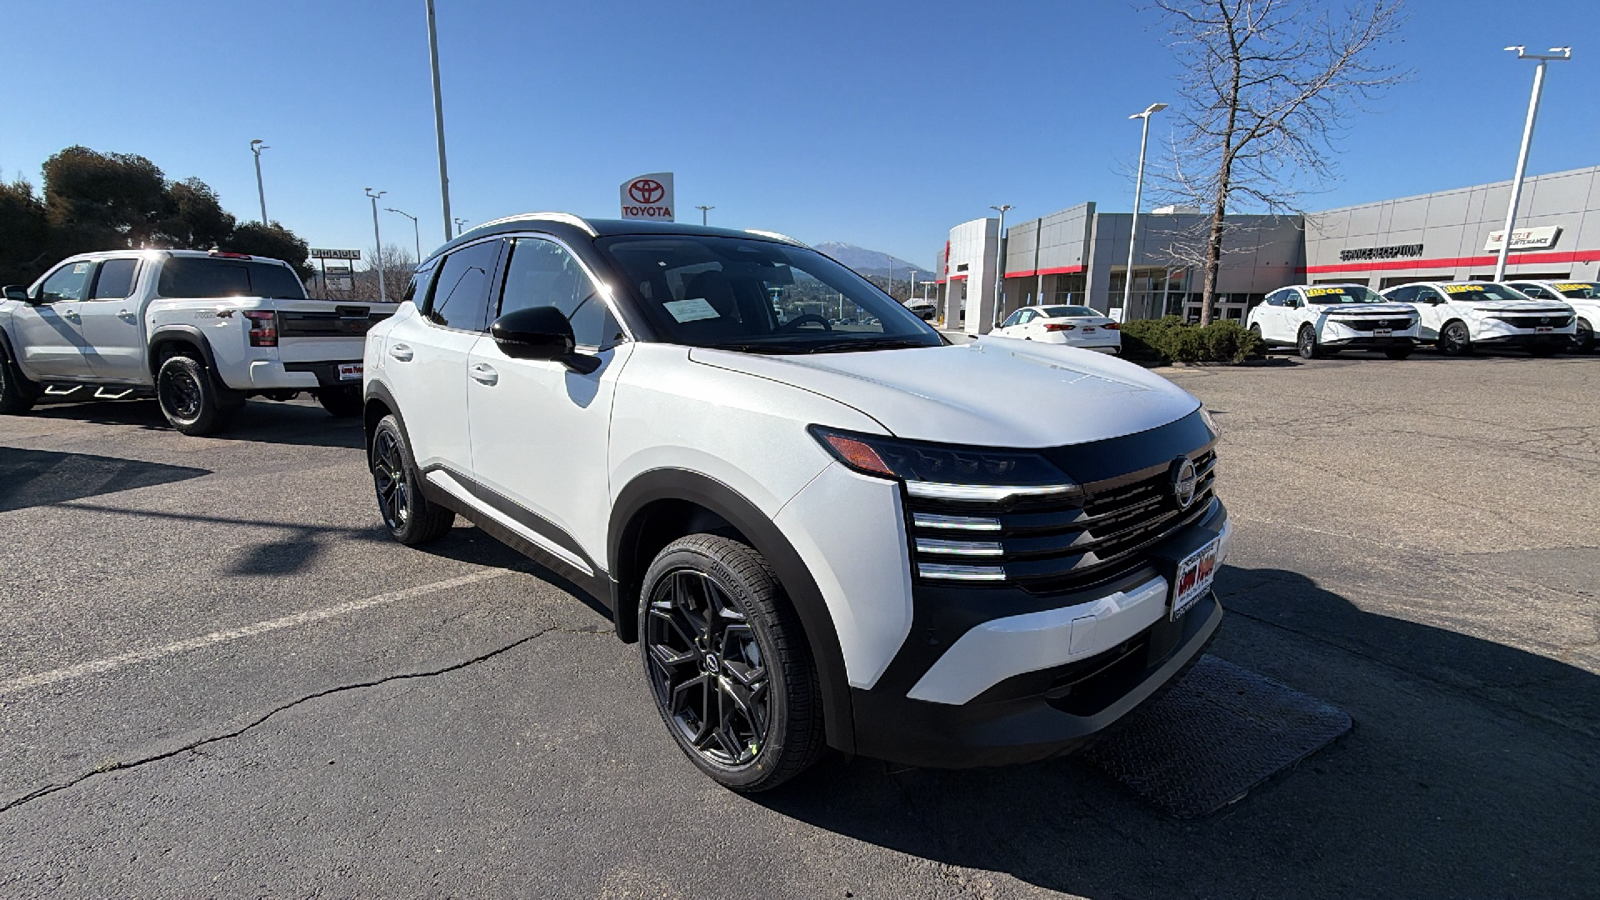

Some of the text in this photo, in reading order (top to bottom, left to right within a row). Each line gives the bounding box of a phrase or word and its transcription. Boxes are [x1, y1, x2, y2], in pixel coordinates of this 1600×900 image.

[622, 206, 672, 217] TOYOTA
[1339, 243, 1424, 261] SERVICE RECEPTION
[710, 561, 761, 621] BRIDGESTONE
